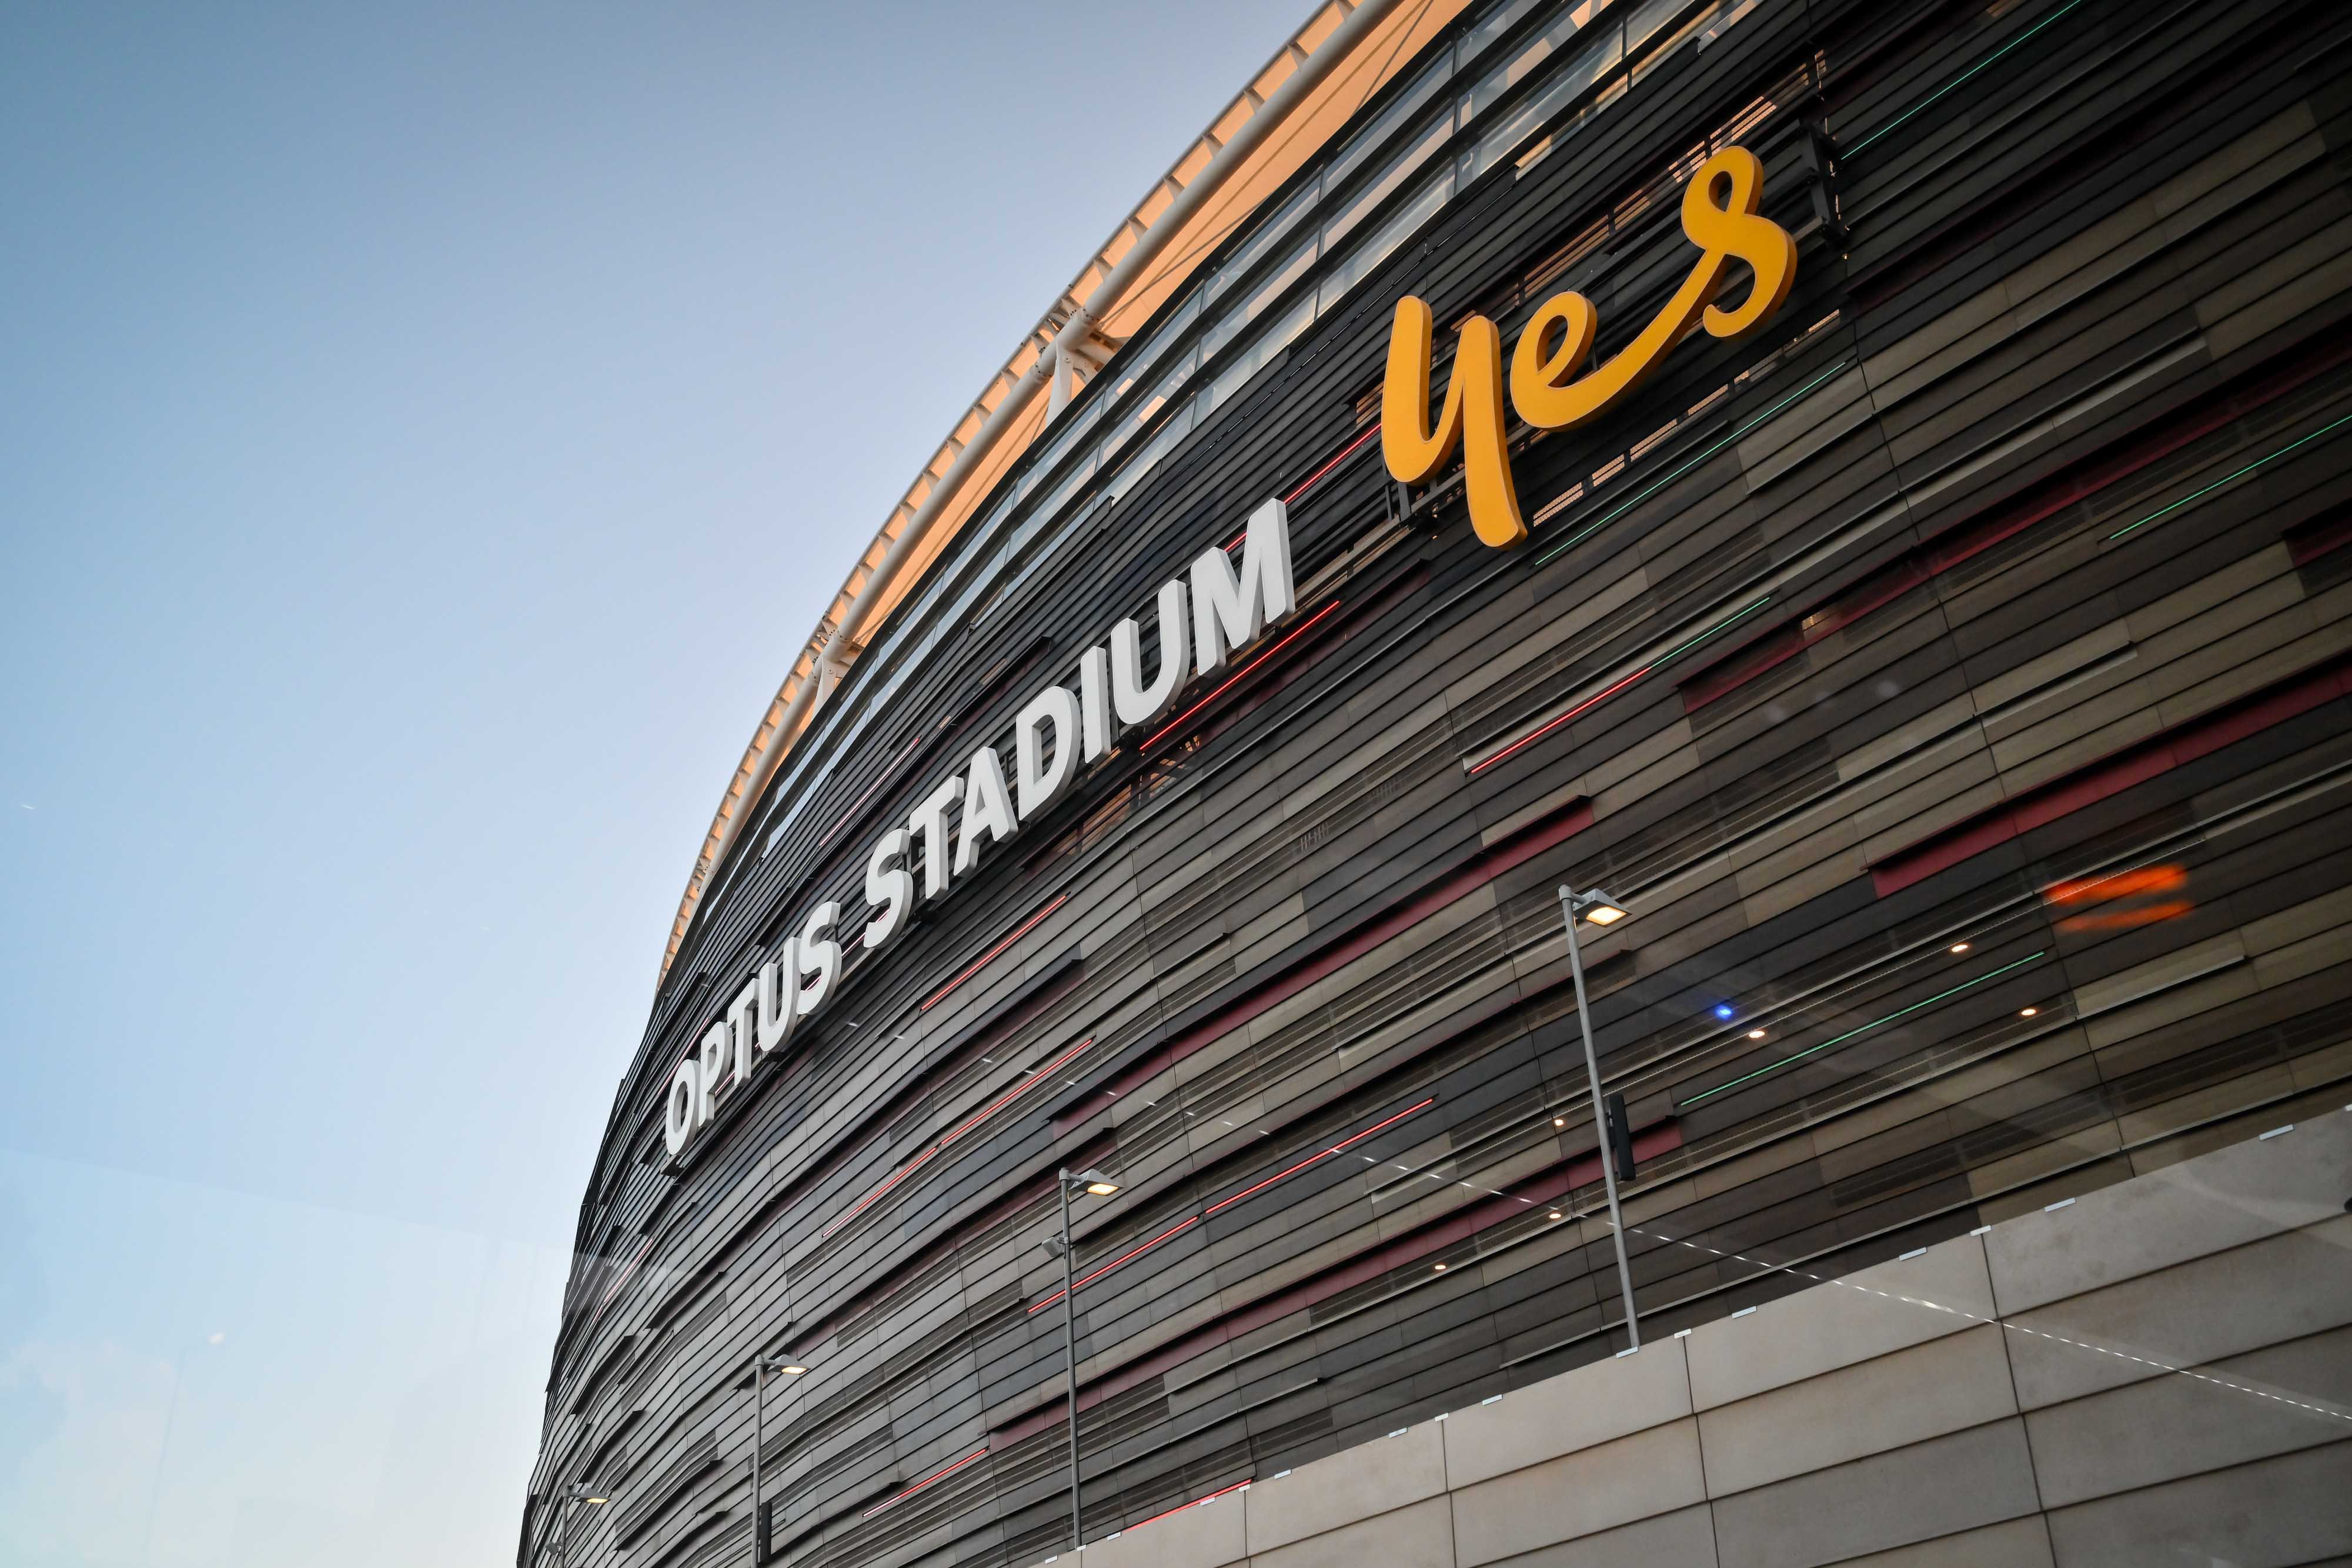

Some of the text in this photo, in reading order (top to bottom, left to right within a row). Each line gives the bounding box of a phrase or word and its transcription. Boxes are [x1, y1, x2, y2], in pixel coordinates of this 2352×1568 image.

[1381, 146, 1797, 550] yes
[665, 497, 1296, 1156] OPTUS STADIUM
